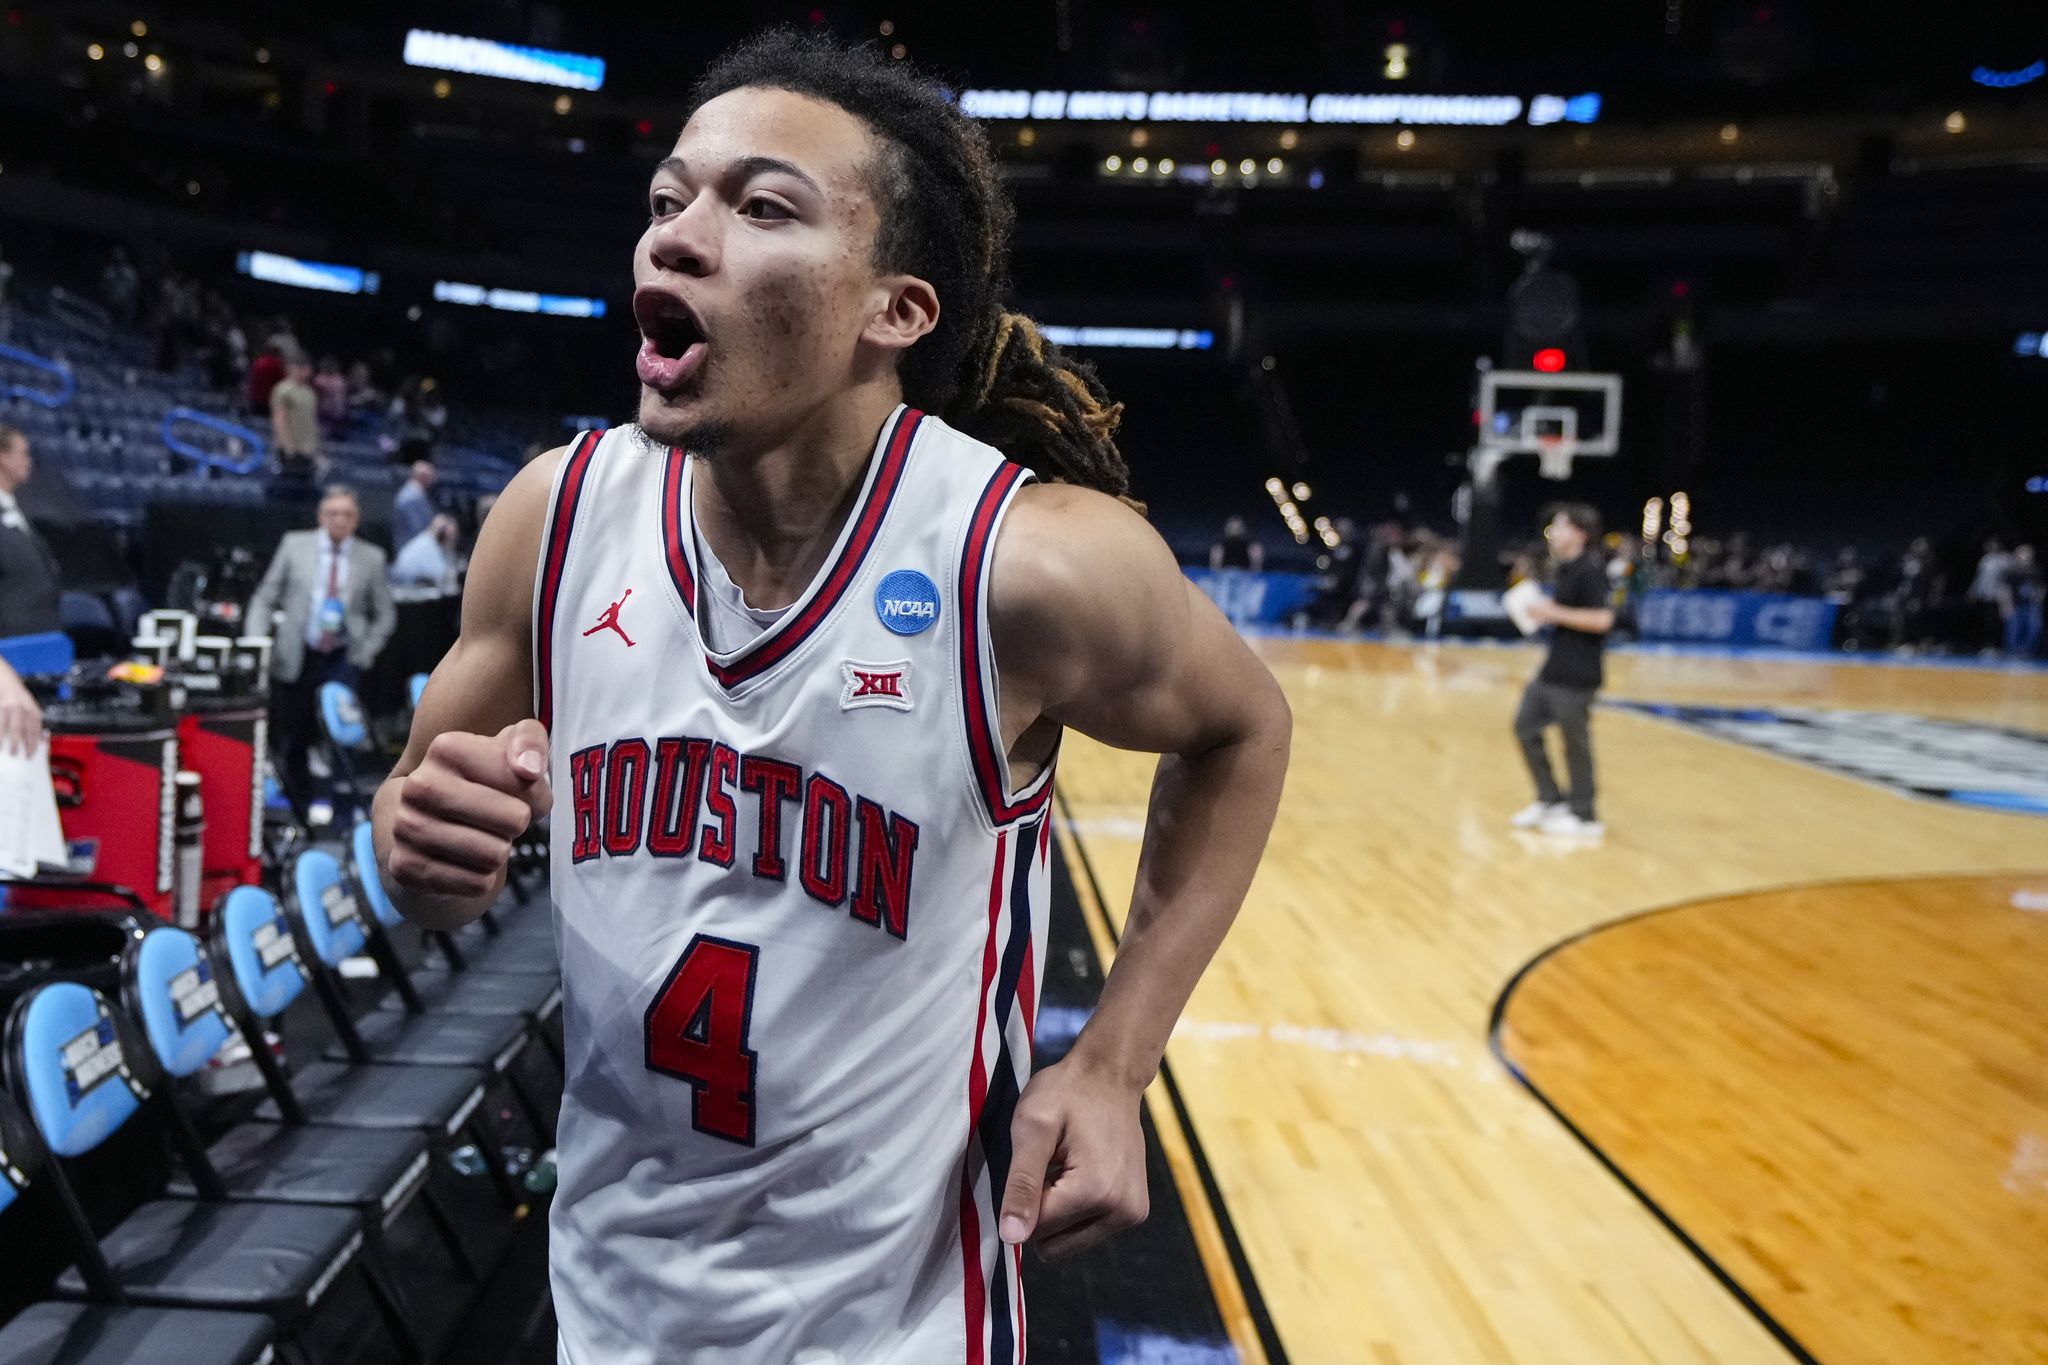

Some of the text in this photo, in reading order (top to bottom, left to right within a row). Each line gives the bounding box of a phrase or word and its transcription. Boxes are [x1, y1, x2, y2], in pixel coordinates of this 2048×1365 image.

[883, 599, 935, 618] NCAA
[852, 671, 903, 698] XII
[570, 737, 920, 940] HOUSTON
[643, 932, 760, 1148] 4
